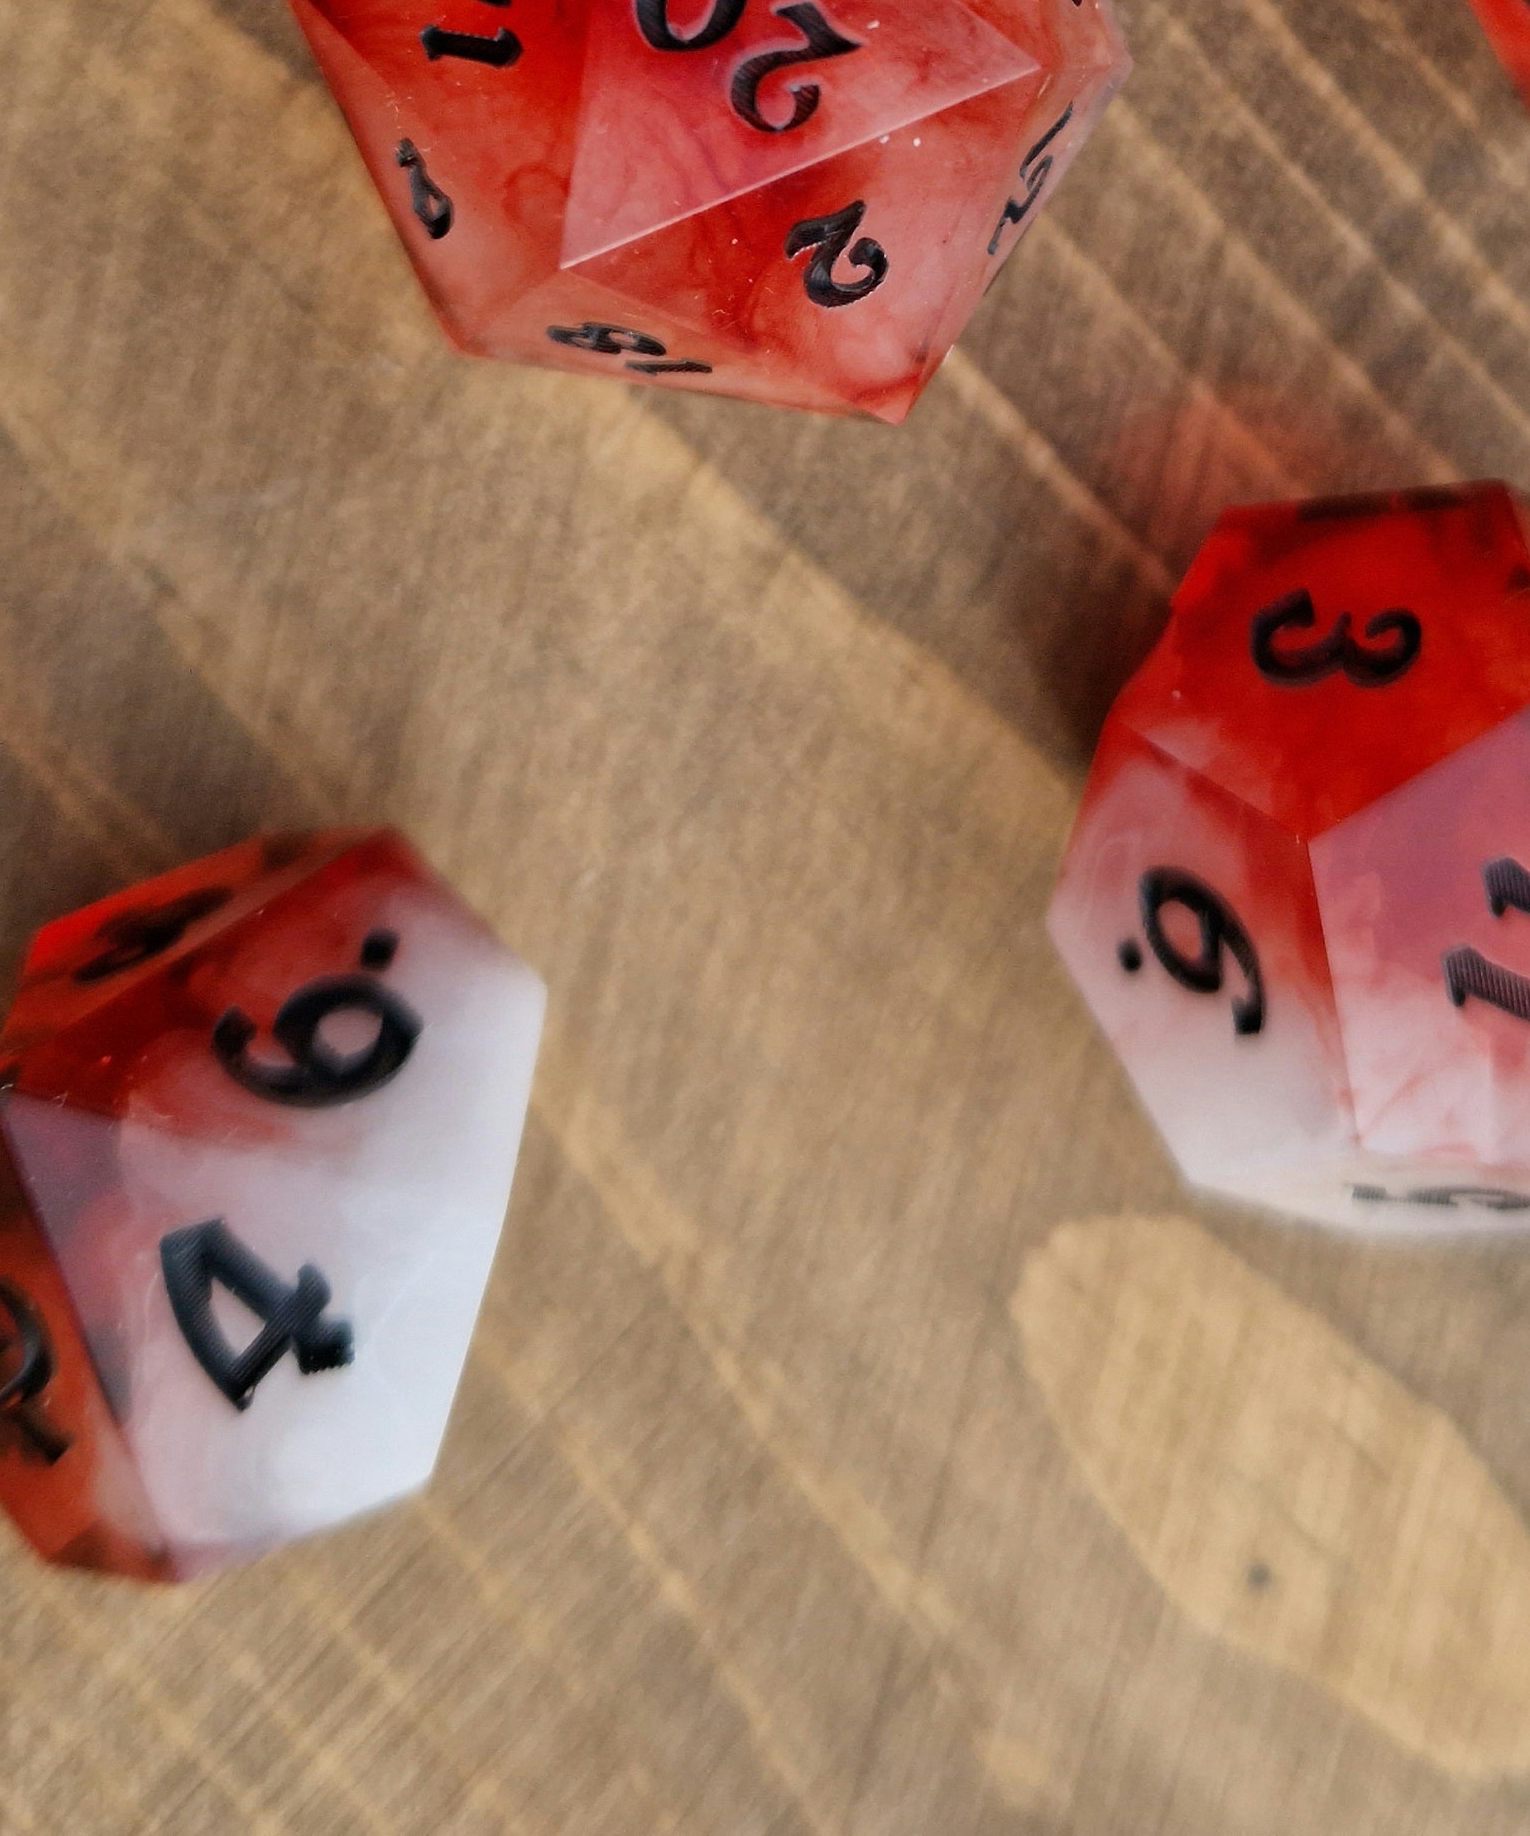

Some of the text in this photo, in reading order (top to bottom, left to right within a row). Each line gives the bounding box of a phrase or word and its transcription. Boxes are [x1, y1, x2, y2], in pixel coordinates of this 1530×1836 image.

[987, 100, 1073, 255] 12
[784, 200, 890, 310] 2
[1250, 588, 1423, 689] 3
[159, 1217, 356, 1412] 4
